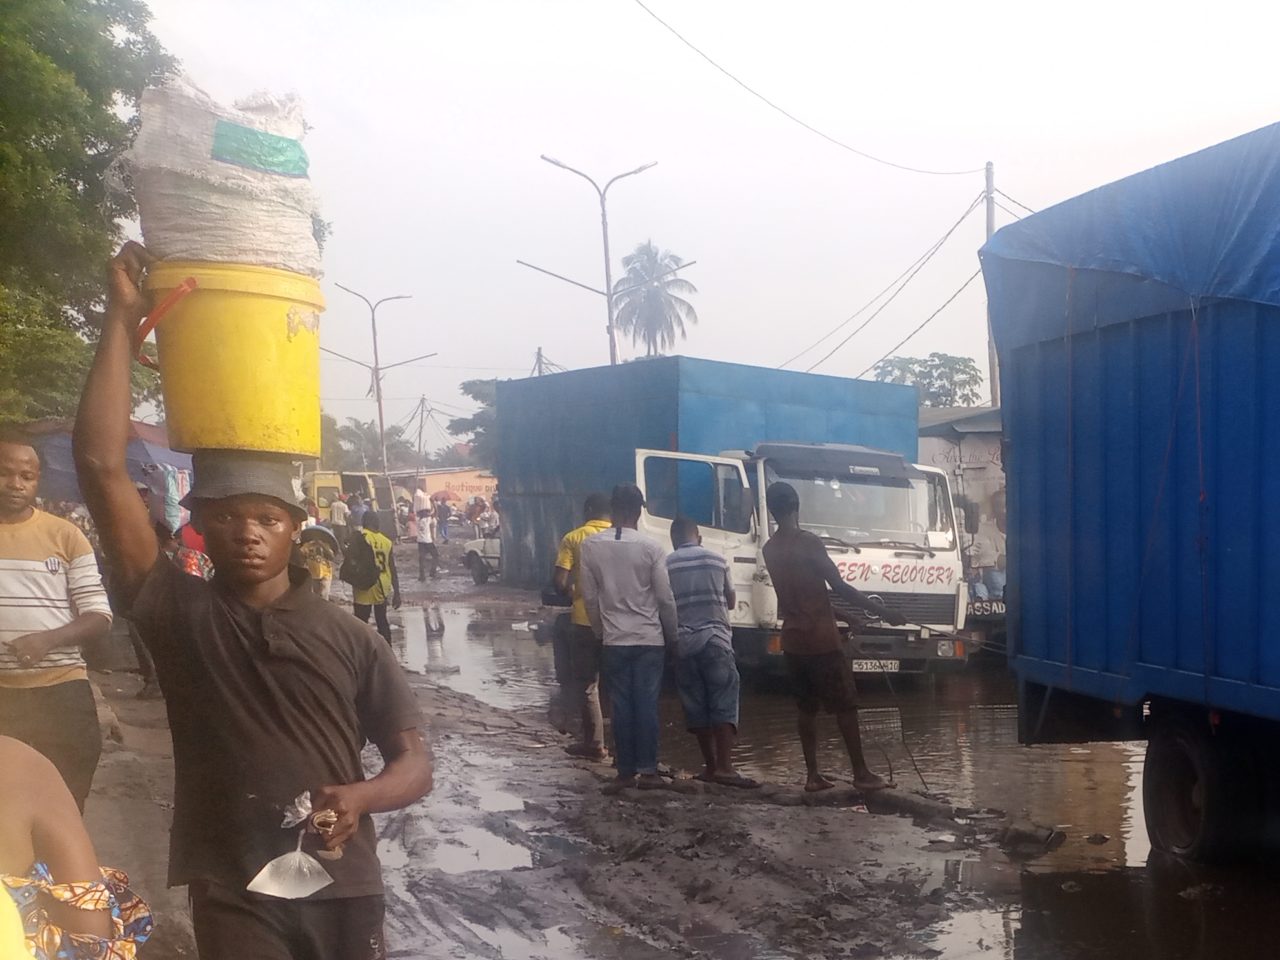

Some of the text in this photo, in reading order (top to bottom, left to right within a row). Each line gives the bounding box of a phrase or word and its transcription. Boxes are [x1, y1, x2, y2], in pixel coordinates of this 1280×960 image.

[837, 561, 954, 585] EEN RECOVERY
[967, 602, 1006, 615] ASSAD
